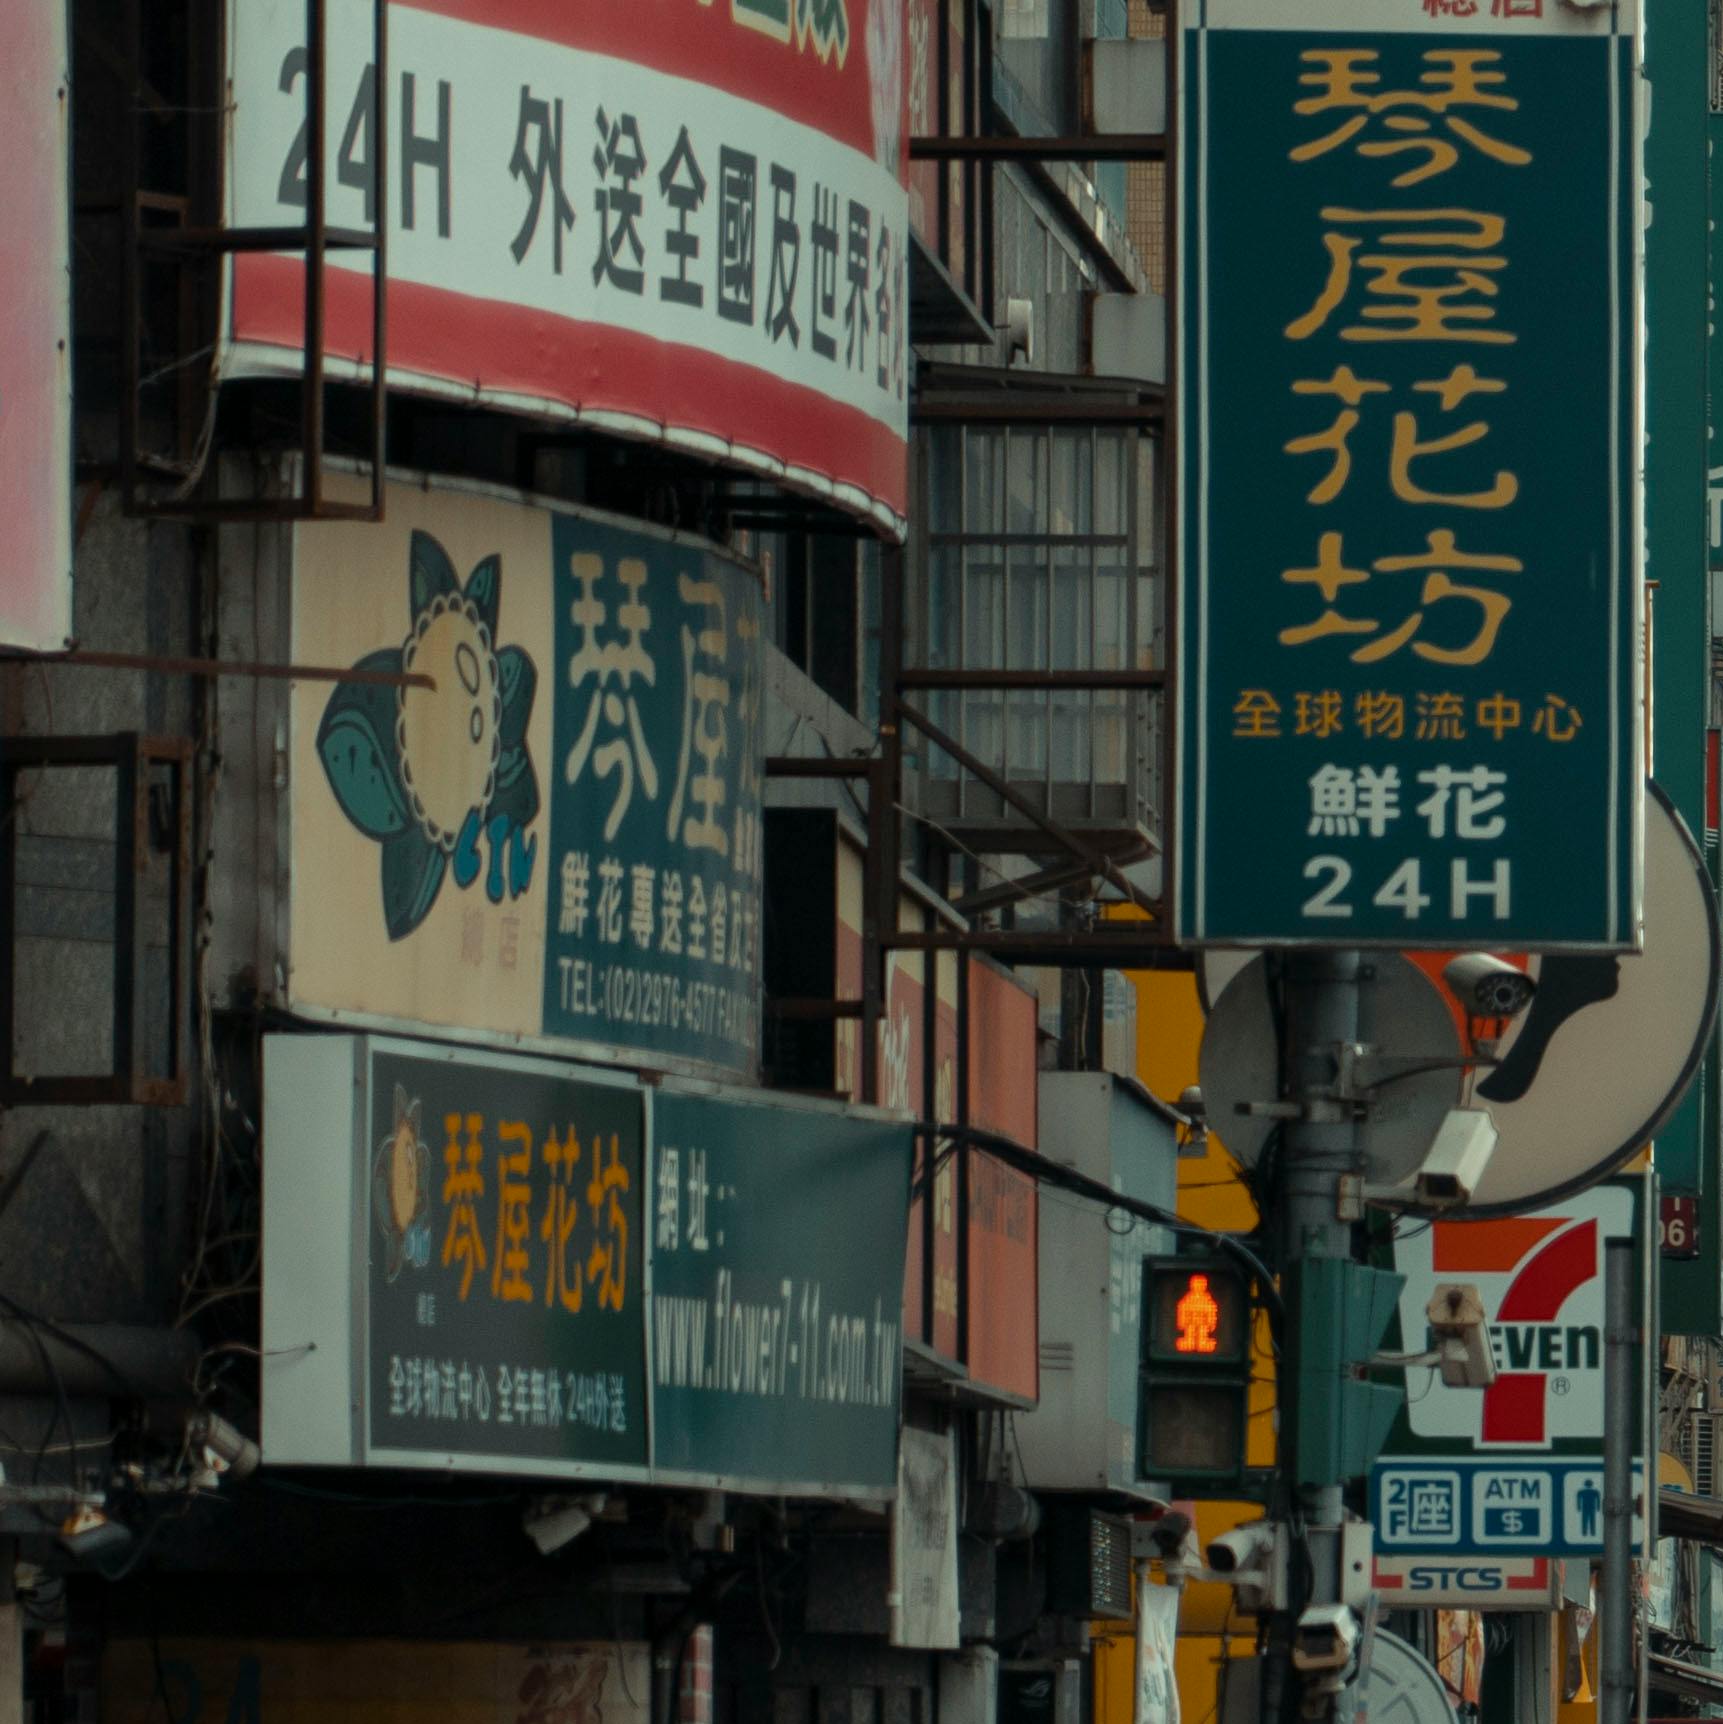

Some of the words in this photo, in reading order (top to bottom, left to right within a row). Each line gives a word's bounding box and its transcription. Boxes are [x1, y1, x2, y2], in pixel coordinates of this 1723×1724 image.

[277, 46, 453, 240] 24H
[1280, 49, 1534, 667] 琴屋花坊
[1231, 690, 1583, 742] 全球物流中心
[1307, 763, 1507, 841] 鮮花
[1301, 856, 1513, 920] 24H
[442, 1112, 630, 1314] 琴屋花坊
[1485, 1479, 1541, 1500] ATM
[1409, 1567, 1504, 1591] STCS
